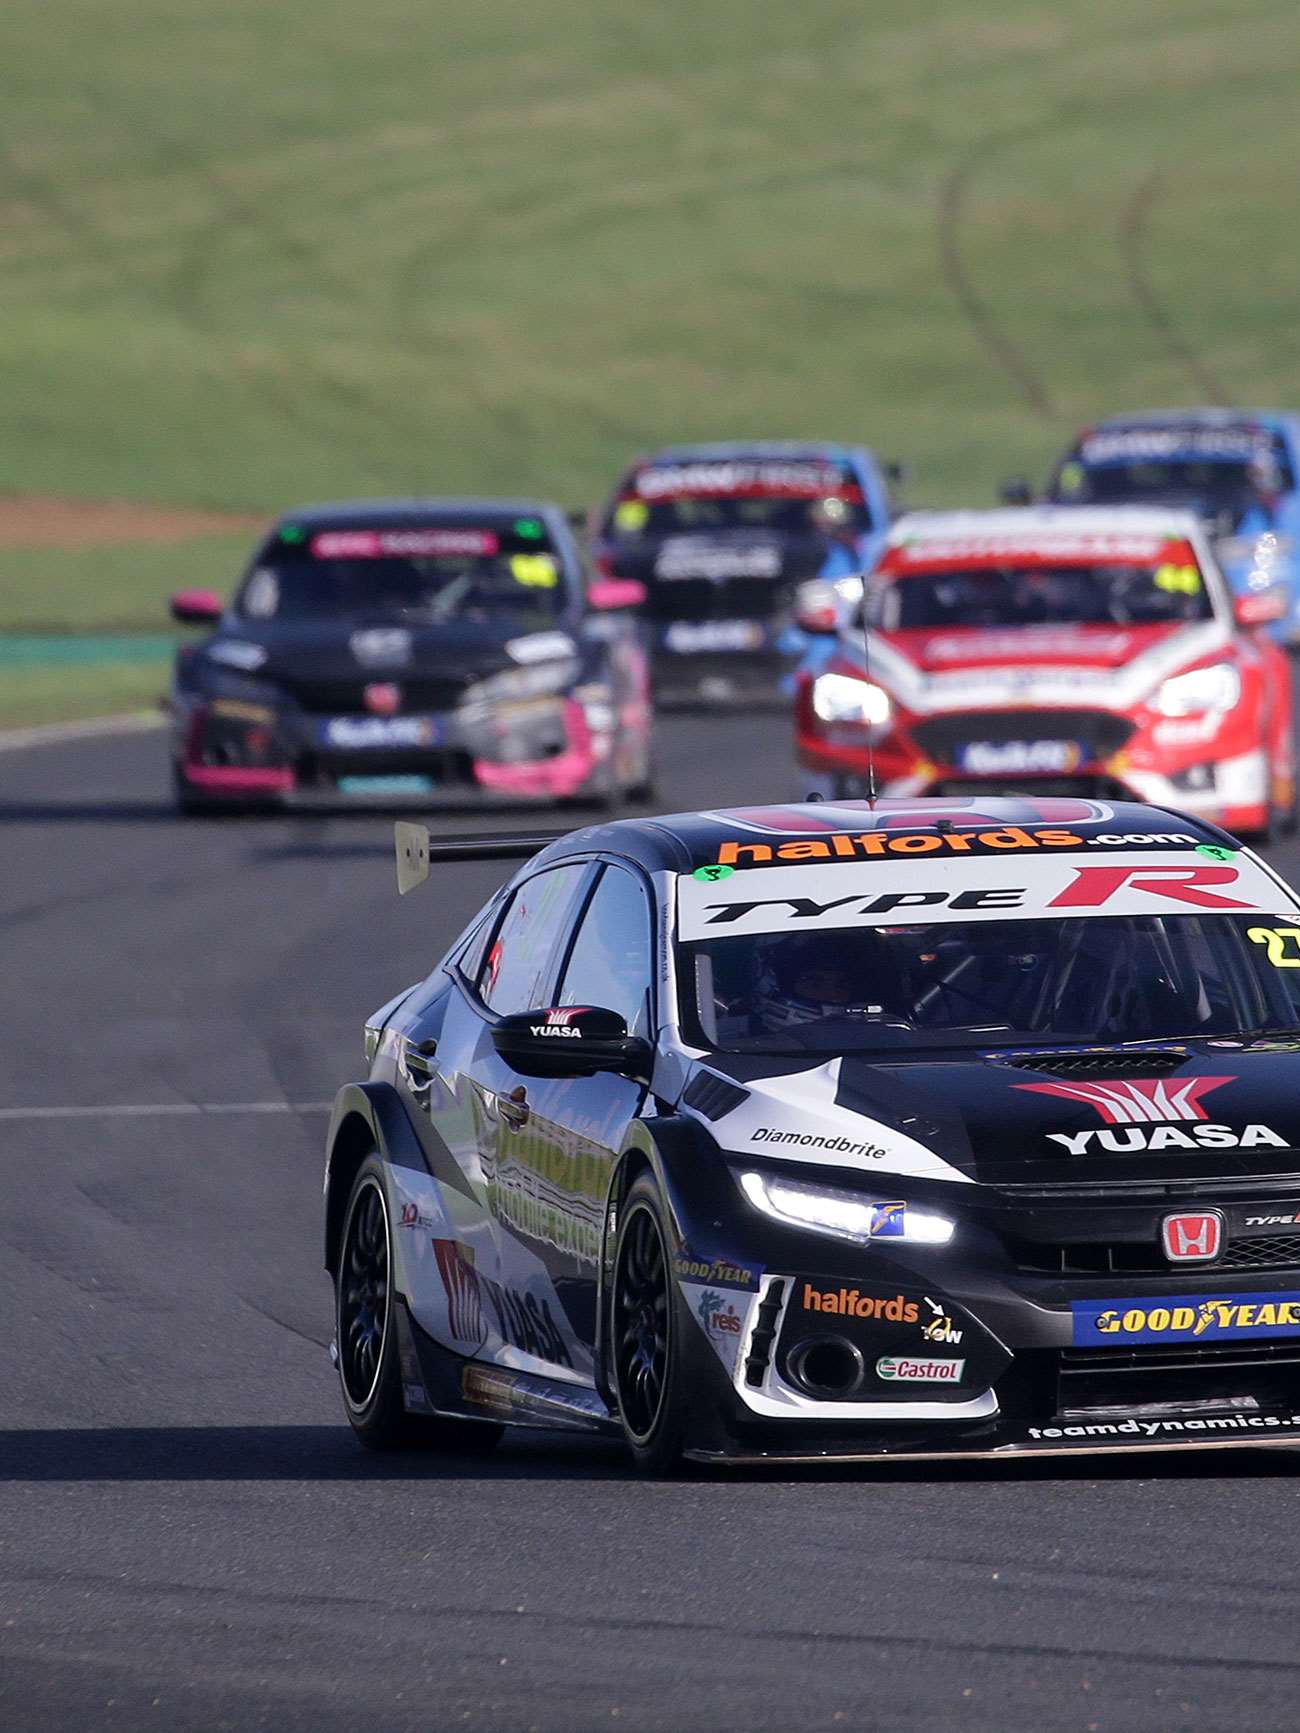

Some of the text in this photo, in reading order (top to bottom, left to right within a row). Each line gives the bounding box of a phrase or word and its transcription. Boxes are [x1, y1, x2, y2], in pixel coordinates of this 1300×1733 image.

[717, 827, 1201, 864] halfords.com
[703, 866, 1262, 924] TYPE R
[530, 1025, 582, 1038] YUASA
[750, 1128, 886, 1159] Diamondbrite
[1045, 1124, 1291, 1156] YUASA
[1245, 1215, 1294, 1226] TYPE
[803, 1283, 920, 1323] halfords
[712, 1304, 742, 1334] reis
[898, 1360, 956, 1379] Castrol
